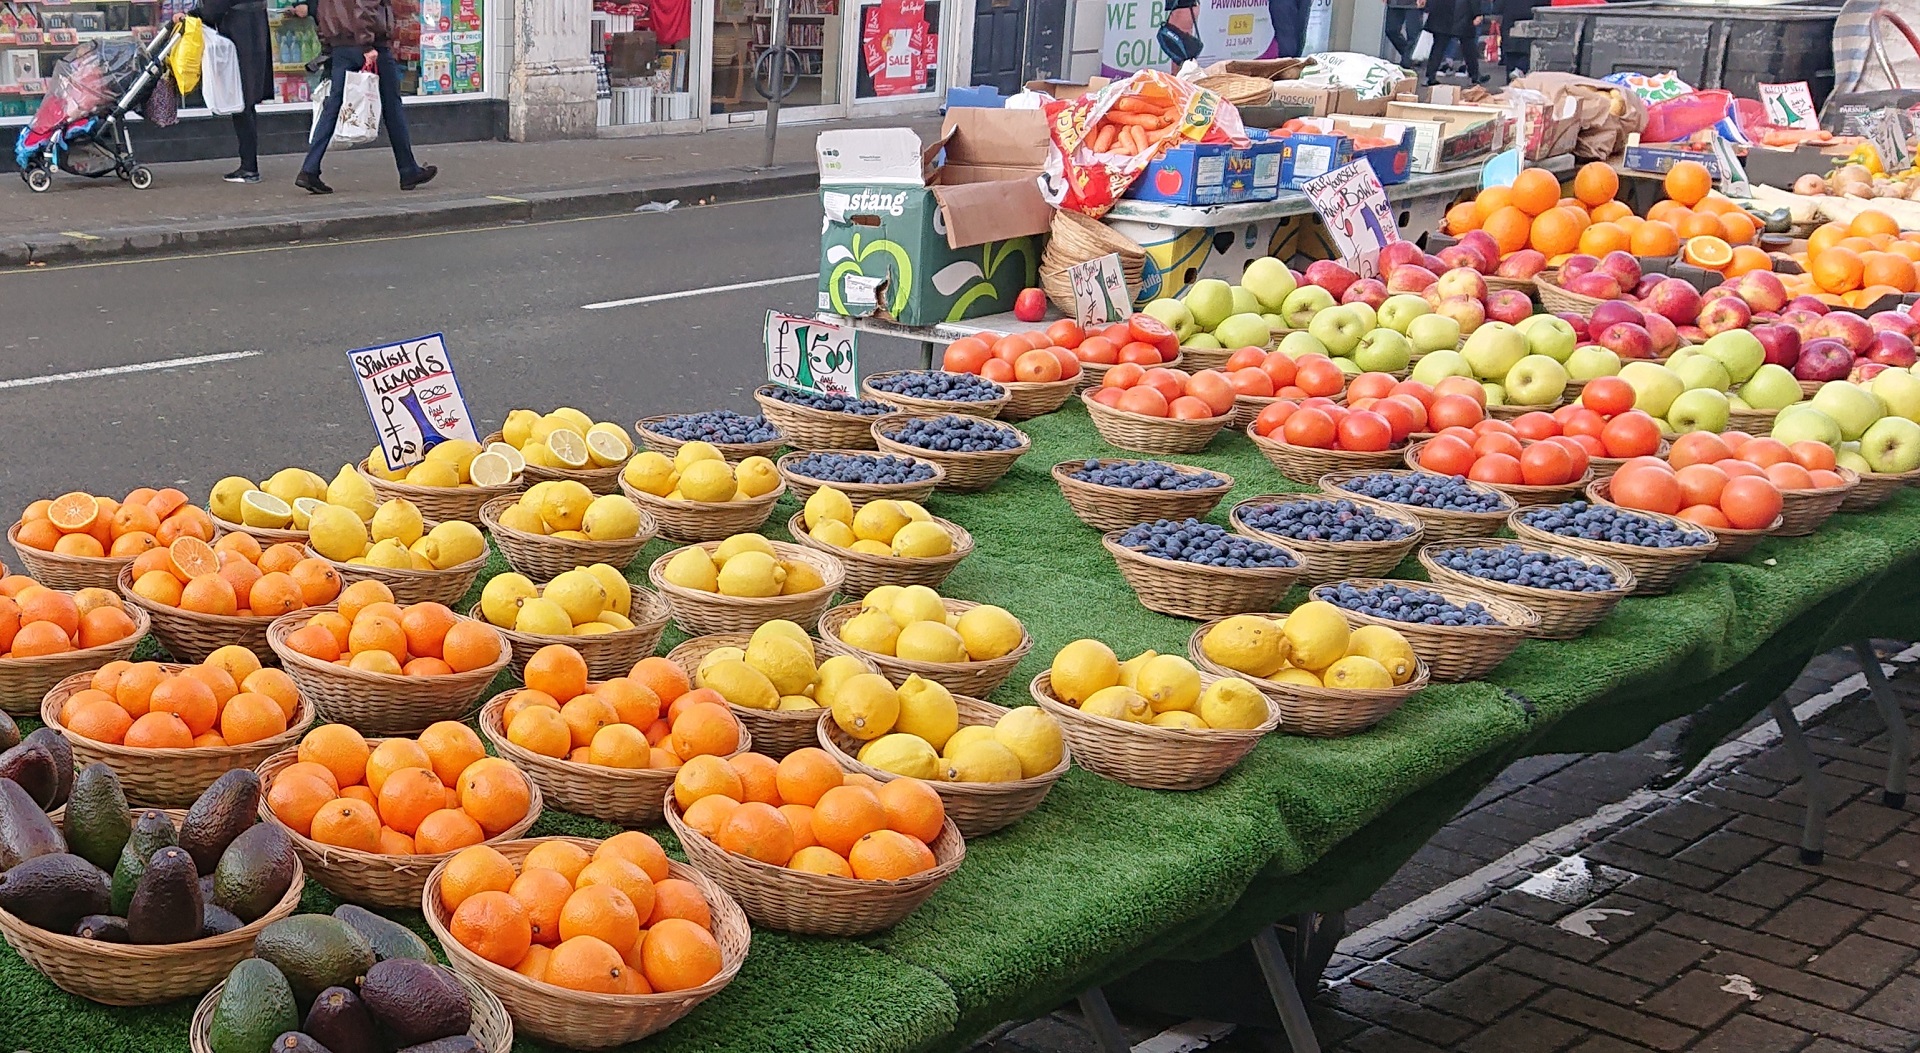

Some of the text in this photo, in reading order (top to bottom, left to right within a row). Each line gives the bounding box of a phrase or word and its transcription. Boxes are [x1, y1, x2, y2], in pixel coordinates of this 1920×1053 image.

[1107, 3, 1138, 30] WE
[889, 55, 910, 66] SALE
[1228, 154, 1252, 173] Nya
[1306, 161, 1359, 197] HELP YOURSELF
[355, 343, 411, 379] SPANISH
[372, 342, 445, 395] LEMONS
